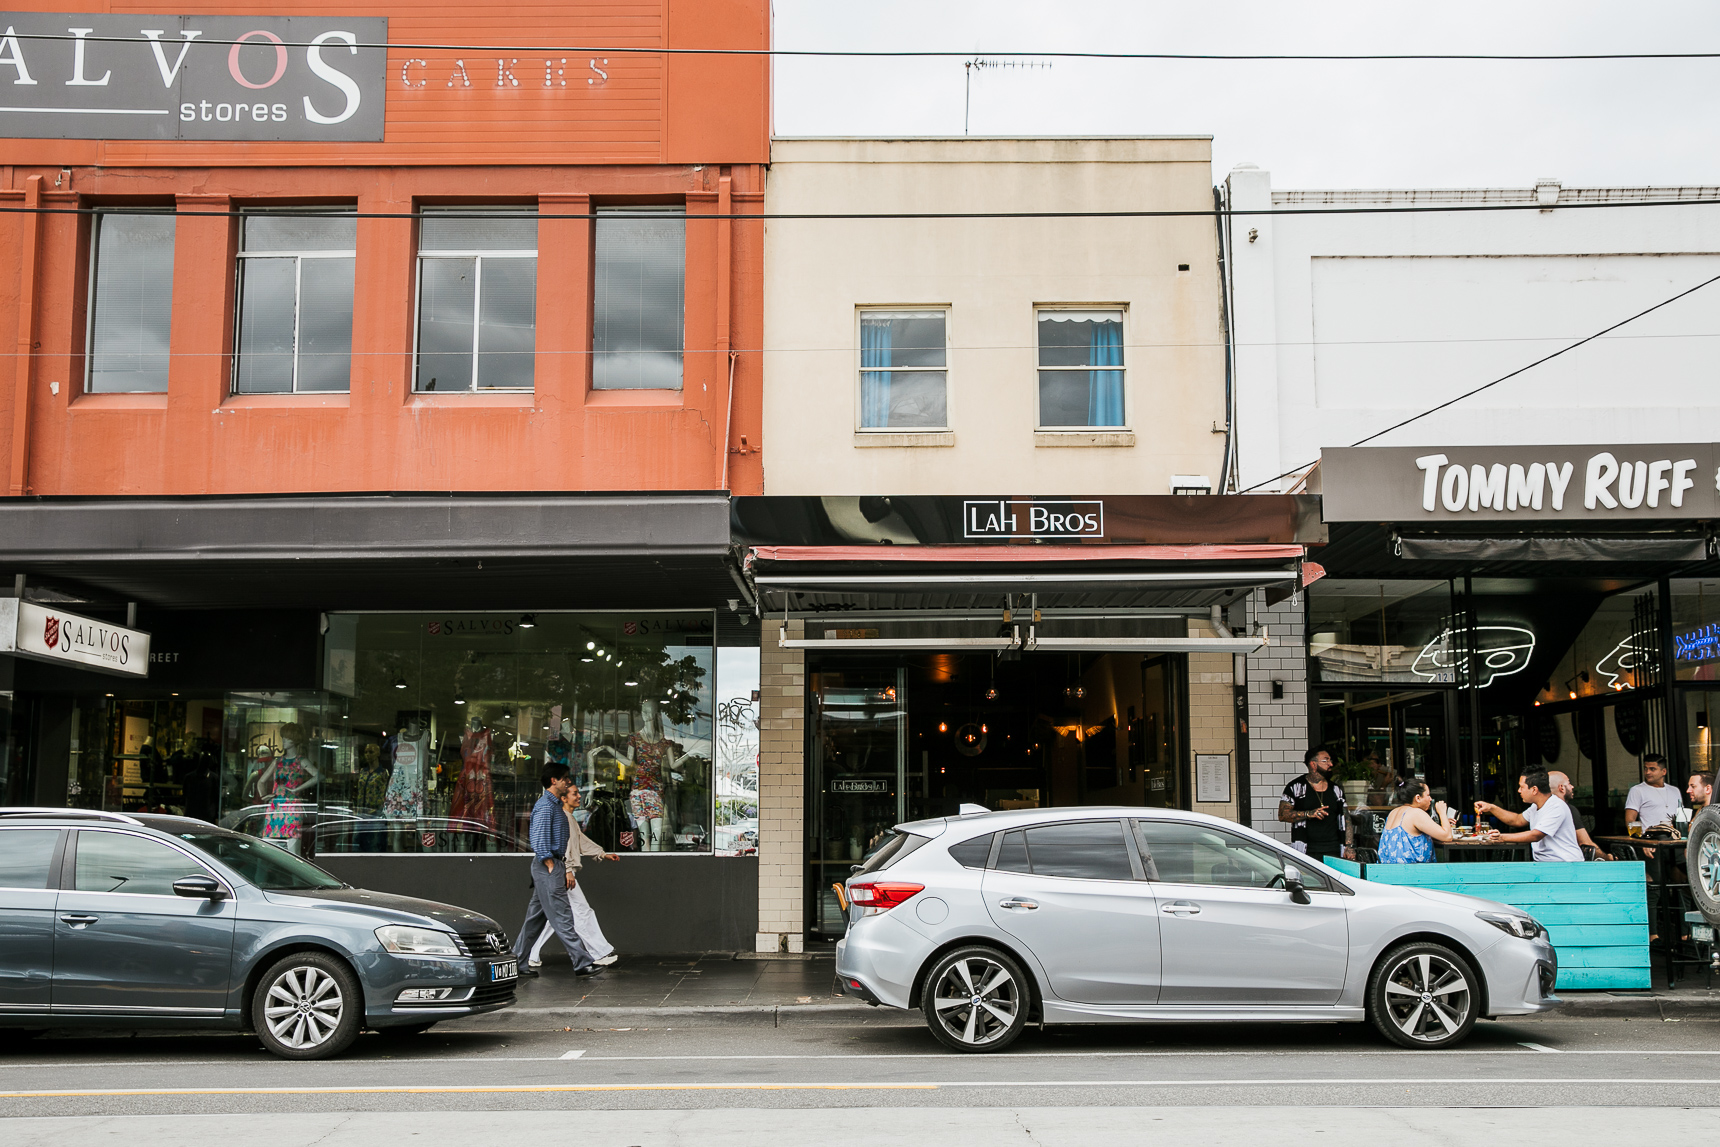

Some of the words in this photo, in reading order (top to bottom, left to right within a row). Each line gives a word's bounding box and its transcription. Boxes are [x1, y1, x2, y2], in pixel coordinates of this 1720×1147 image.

[402, 58, 608, 87] CAKES
[179, 100, 288, 122] stores
[1415, 454, 1574, 512] TOMMY
[1584, 452, 1697, 510] RUFF
[1030, 507, 1098, 532] BROS
[443, 620, 513, 635] SALVOS
[640, 619, 709, 634] SALVOS
[61, 620, 129, 665] SALVOS
[1437, 673, 1454, 682] 121
